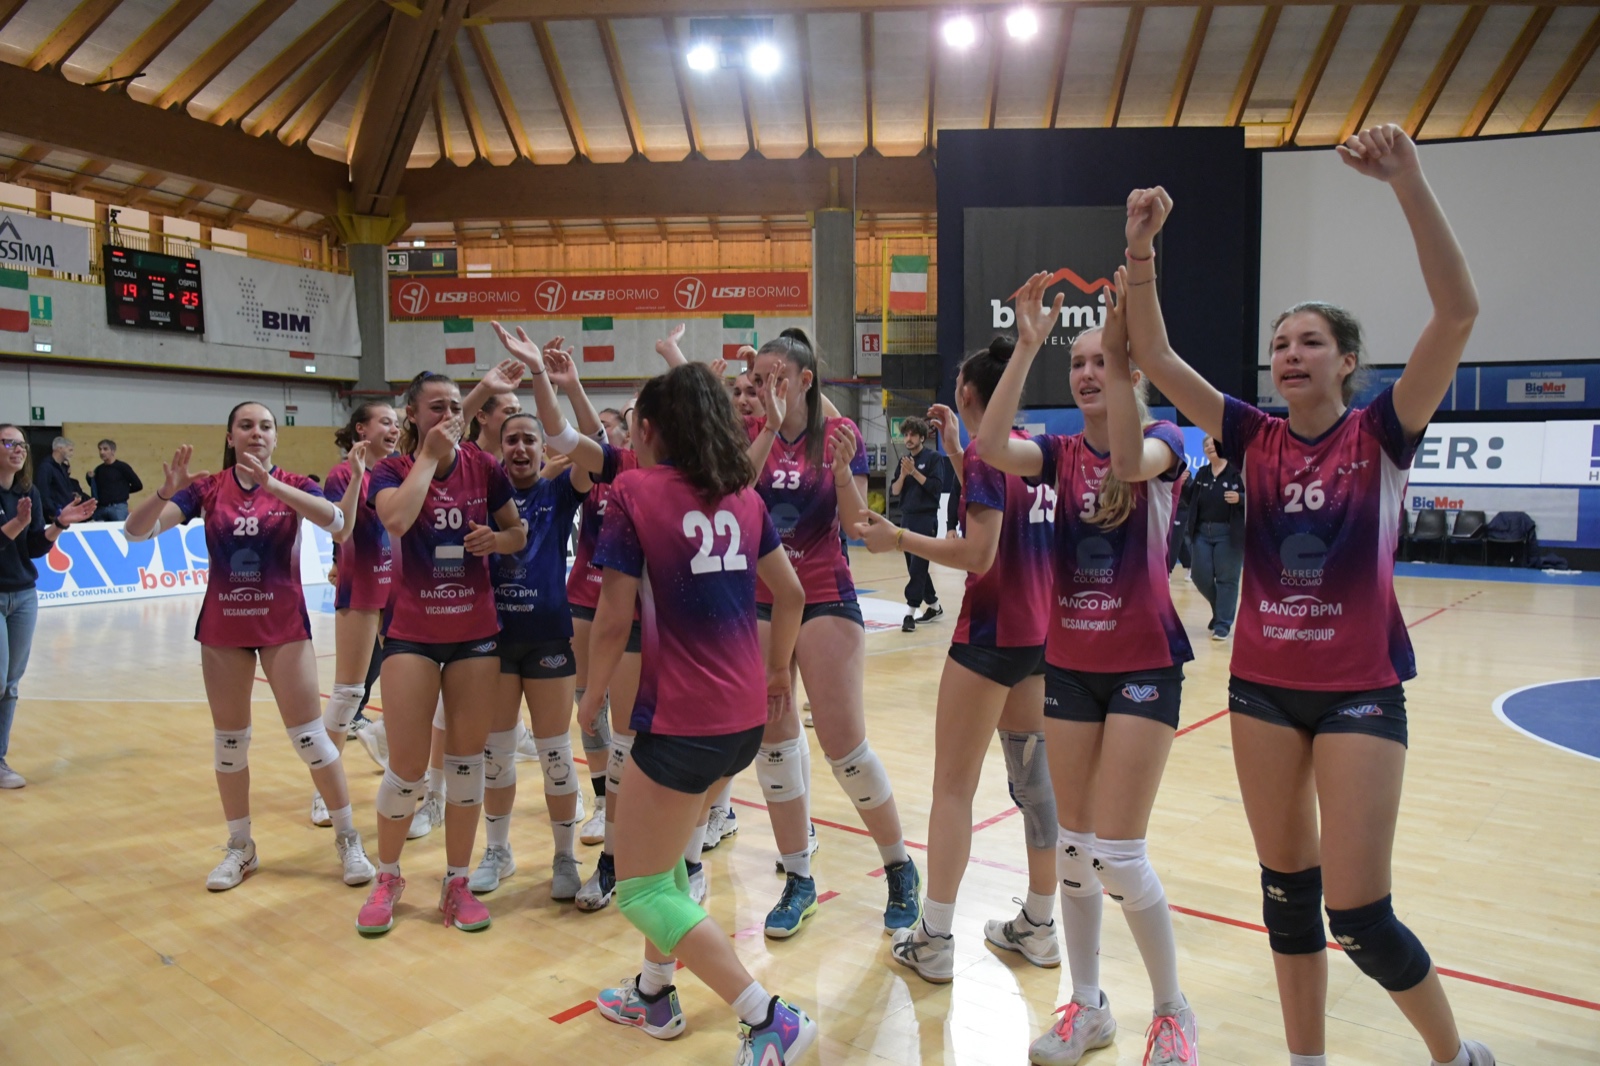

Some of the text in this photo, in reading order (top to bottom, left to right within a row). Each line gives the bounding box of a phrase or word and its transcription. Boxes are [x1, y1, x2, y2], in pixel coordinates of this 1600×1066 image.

[114, 269, 137, 279] LOCALI
[123, 284, 137, 298] 19
[435, 291, 520, 303] USB BORMIO
[572, 288, 659, 301] USB BORMIO
[711, 285, 800, 298] USB BORMIO
[181, 291, 199, 307] 25
[991, 294, 1108, 329] bmi
[262, 310, 311, 333] BIM
[1525, 382, 1566, 394] BigMat
[772, 470, 801, 490] 23
[1284, 480, 1325, 513] 26
[1412, 496, 1464, 511] BigMat
[434, 508, 463, 530] 30
[233, 516, 259, 536] 28
[682, 509, 748, 575] 22
[433, 571, 465, 579] COLOMBO
[1074, 568, 1114, 577] ALFREDO
[1280, 568, 1324, 578] ALFREDO
[1073, 576, 1113, 584] COLOMBO
[1280, 577, 1322, 587] COLOMBO
[72, 587, 124, 598] COMUNALE
[218, 592, 274, 602] BANCO BPM
[420, 589, 457, 599] BANCO
[519, 589, 538, 598] BPM
[1058, 595, 1098, 610] ANCO
[1259, 600, 1343, 617] BANCO BPM
